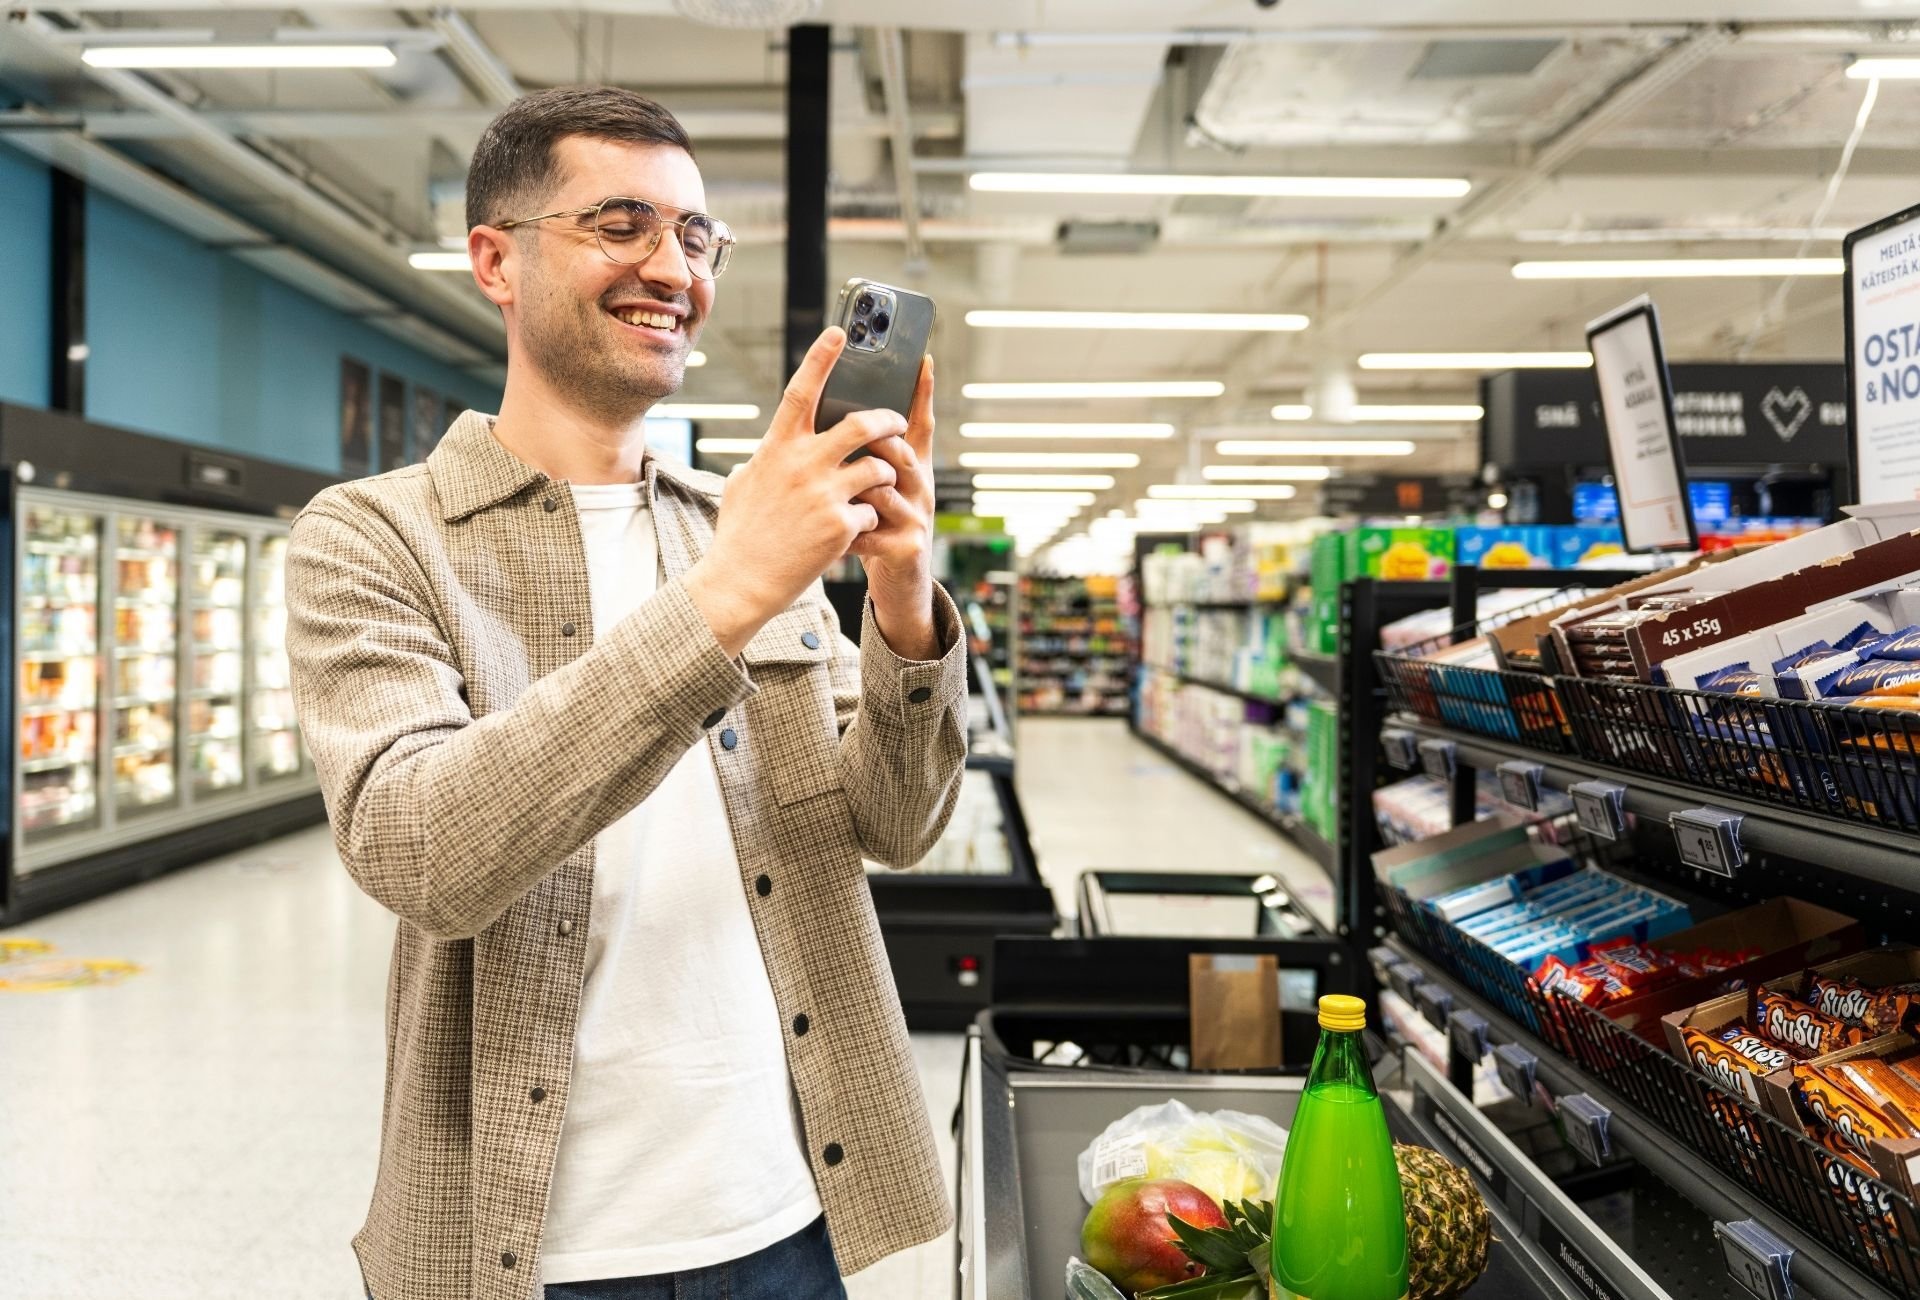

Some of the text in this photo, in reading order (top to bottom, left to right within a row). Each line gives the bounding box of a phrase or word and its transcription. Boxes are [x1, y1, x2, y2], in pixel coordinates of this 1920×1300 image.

[1880, 232, 1915, 261] MEILTÄ
[1861, 259, 1909, 291] KÄTEISTÄ
[1662, 618, 1721, 646] 45 x 55g
